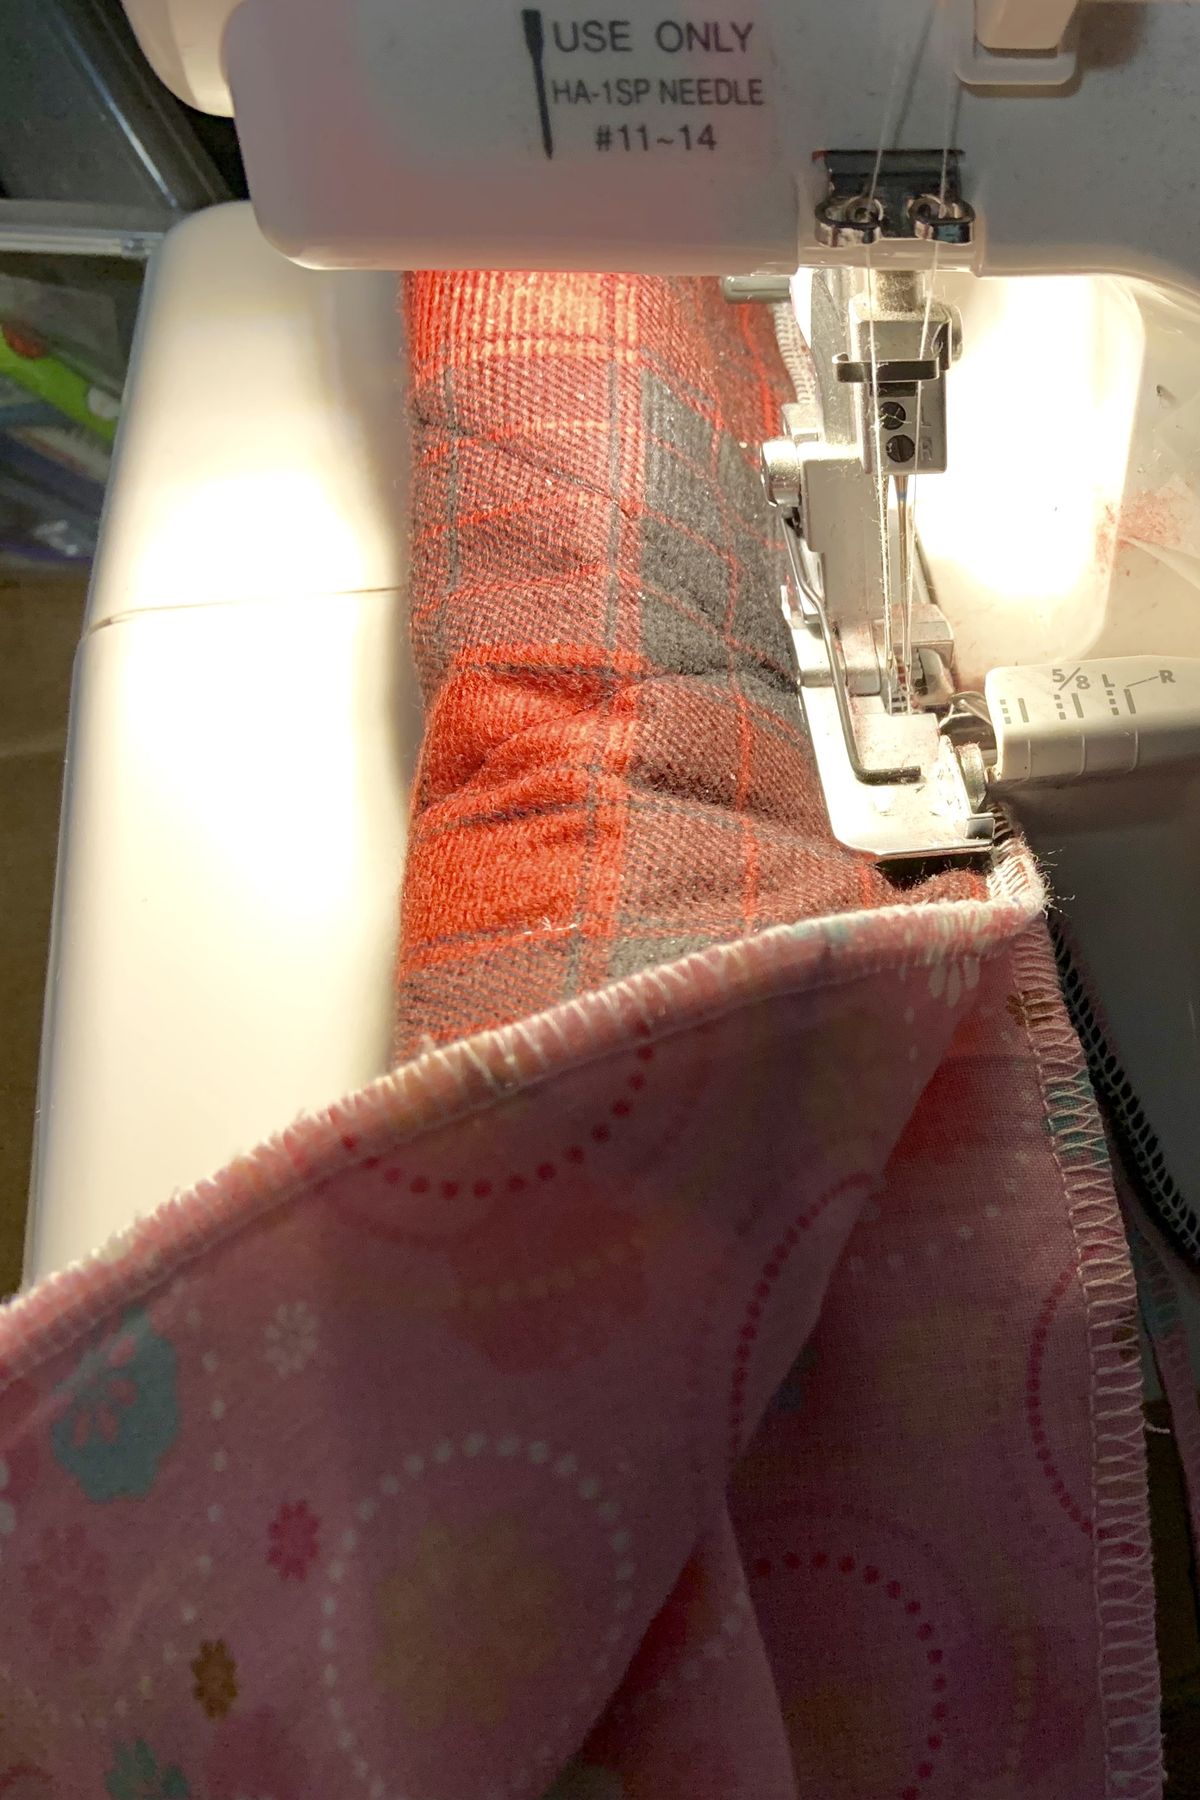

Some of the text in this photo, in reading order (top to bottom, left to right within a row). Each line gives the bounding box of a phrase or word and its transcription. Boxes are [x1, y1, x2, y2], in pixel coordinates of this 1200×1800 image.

[552, 19, 754, 53] USE ONLY
[551, 78, 765, 106] HA-1SP NEEDLE
[1051, 666, 1177, 691] 5/8 L R
